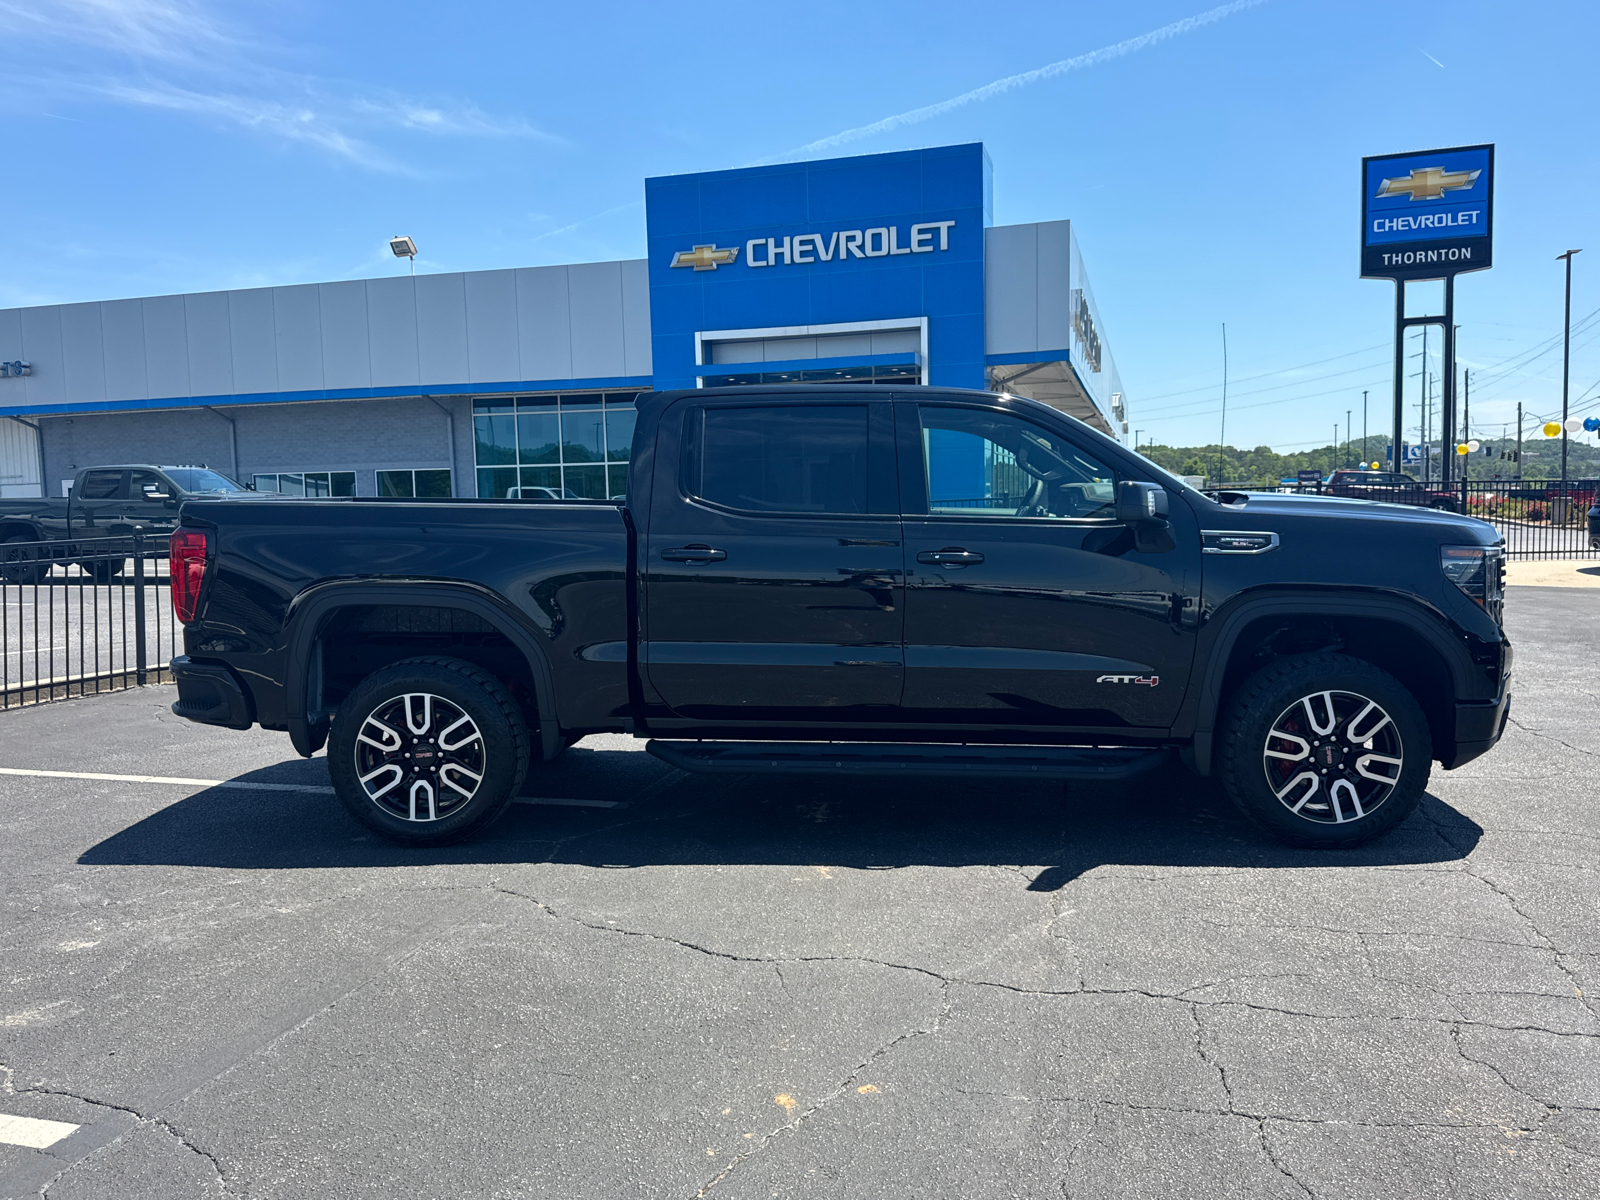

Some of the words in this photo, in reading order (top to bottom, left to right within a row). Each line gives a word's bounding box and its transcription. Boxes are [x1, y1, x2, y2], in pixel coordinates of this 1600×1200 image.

[1373, 210, 1480, 233] CHEVROLET
[746, 220, 955, 267] CHEVROLET
[1382, 247, 1471, 266] THORNTON
[1096, 674, 1159, 688] AT4
